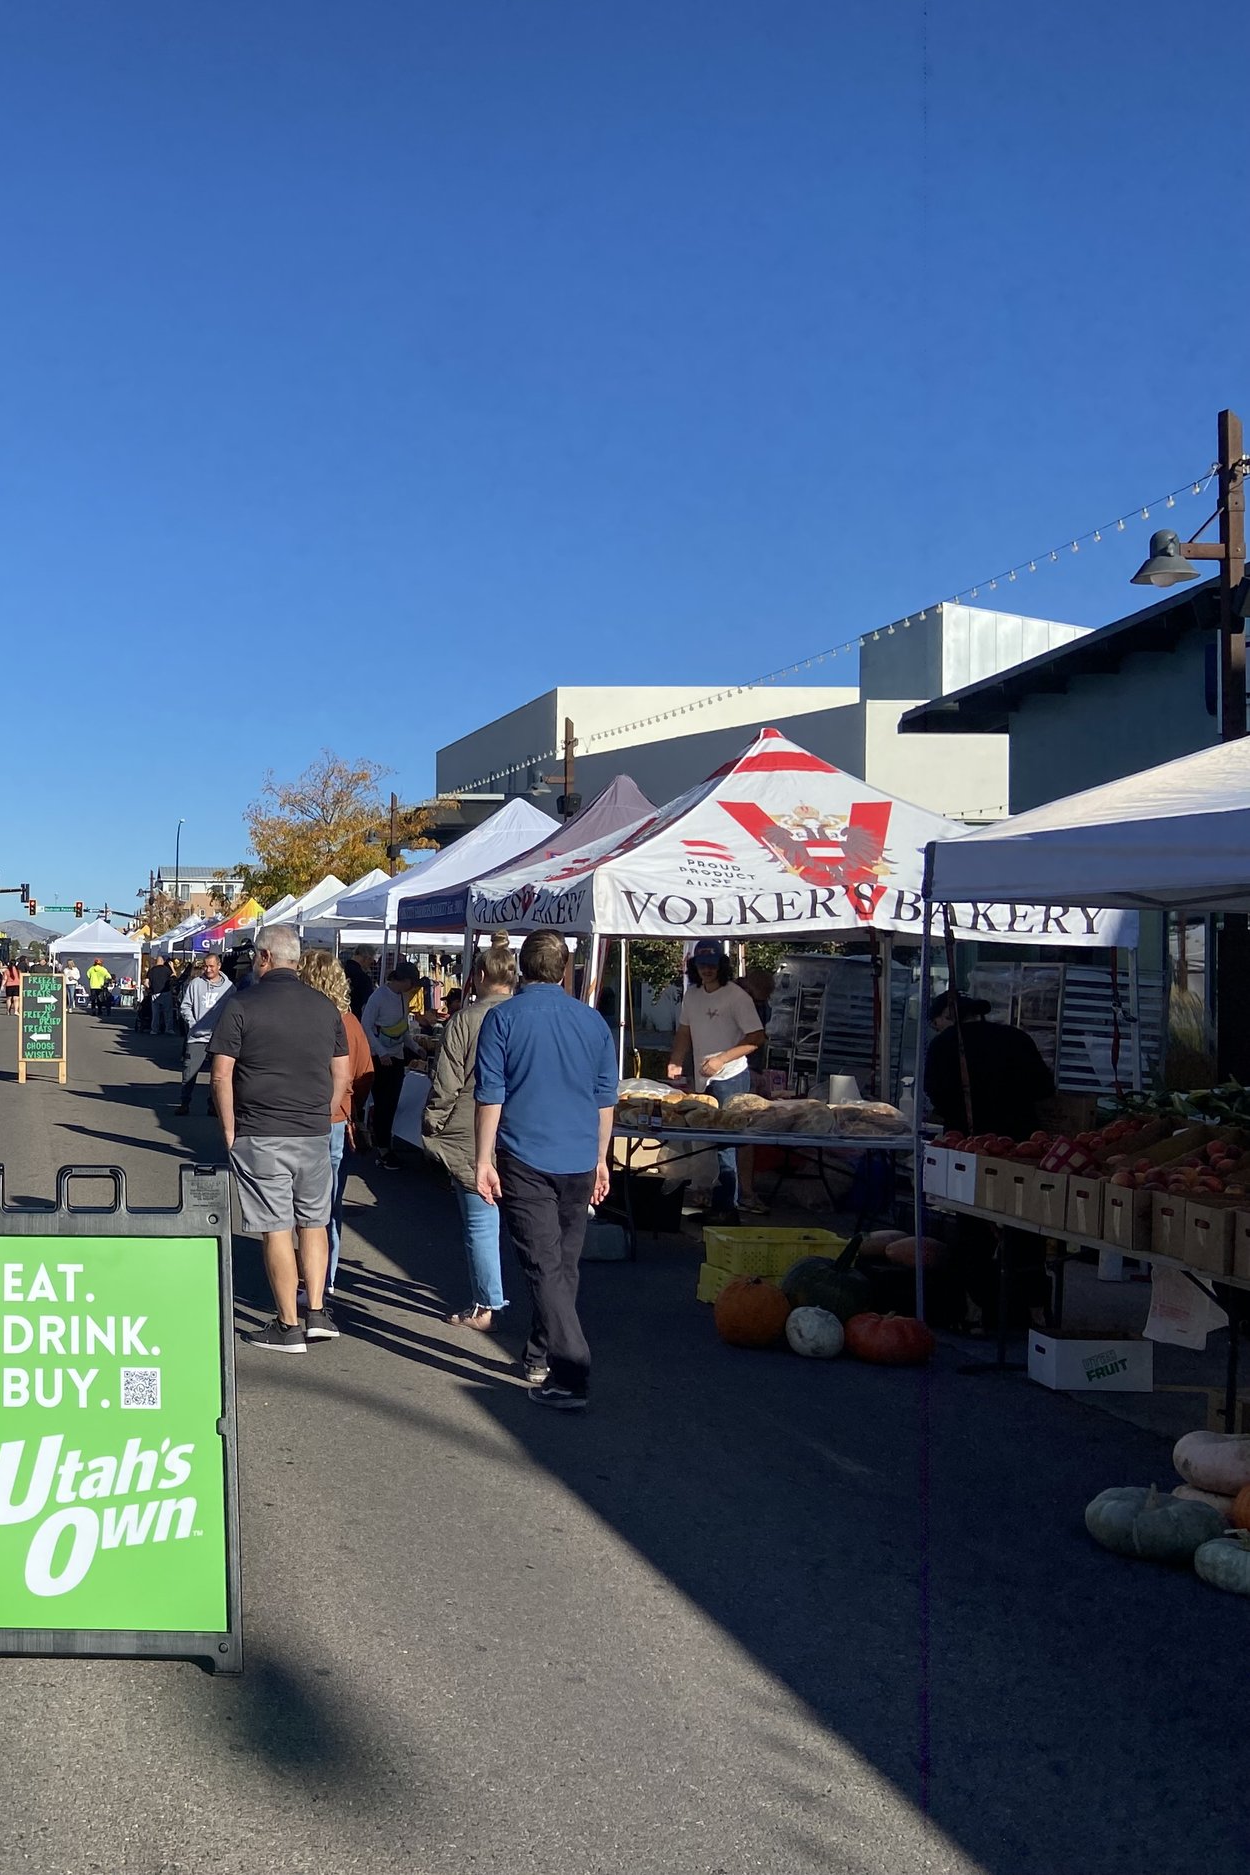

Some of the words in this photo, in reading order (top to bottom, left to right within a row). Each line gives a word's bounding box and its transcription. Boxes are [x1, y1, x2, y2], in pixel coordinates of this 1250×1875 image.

[687, 858, 741, 872] PROUD
[679, 866, 757, 881] PRODUCT
[621, 882, 875, 926] VOLKER'S
[890, 889, 1102, 934] BAKERY
[29, 976, 56, 984] FREEZE
[45, 1004, 56, 1012] NO
[24, 1025, 52, 1033] TREATS
[26, 1042, 55, 1050] CHOOSE
[24, 1051, 54, 1059] WISELY
[3, 1262, 95, 1303] EAT.
[2, 1314, 161, 1356] DRINK.
[1086, 1358, 1128, 1382] FRUIT
[2, 1367, 111, 1409] BUY.
[24, 1496, 198, 1598] Own
